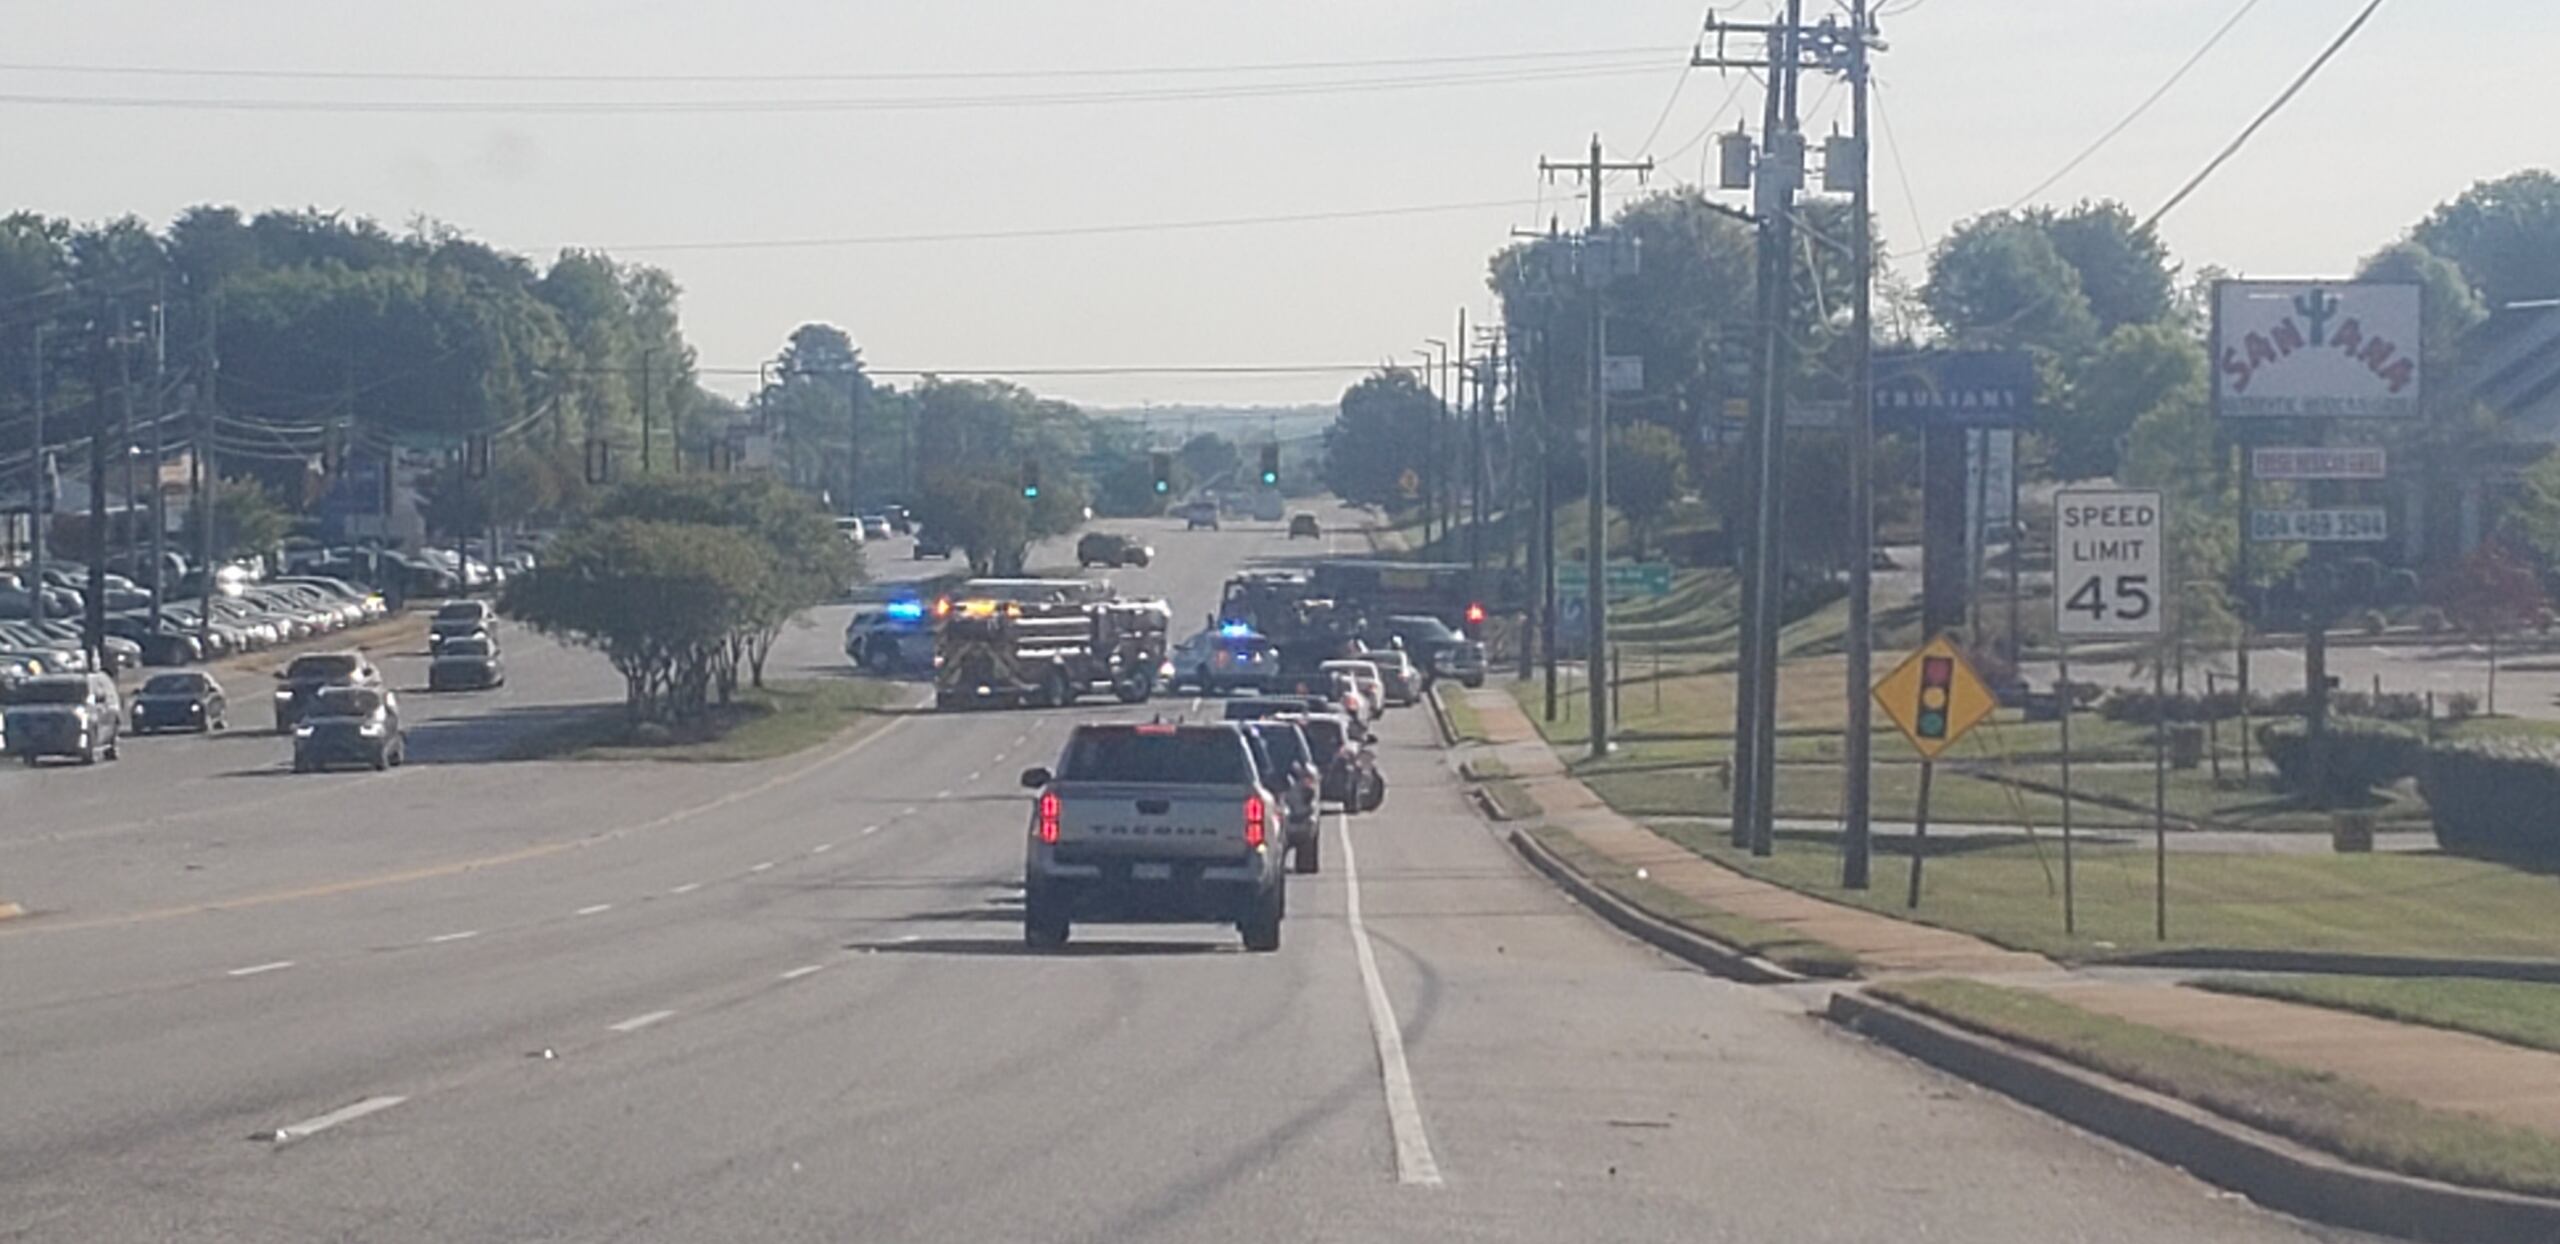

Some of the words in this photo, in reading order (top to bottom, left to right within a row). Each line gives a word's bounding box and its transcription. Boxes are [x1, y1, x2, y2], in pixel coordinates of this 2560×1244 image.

[2064, 506, 2154, 528] SPEED
[2072, 539, 2145, 562] LIMIT
[2065, 575, 2153, 621] 45
